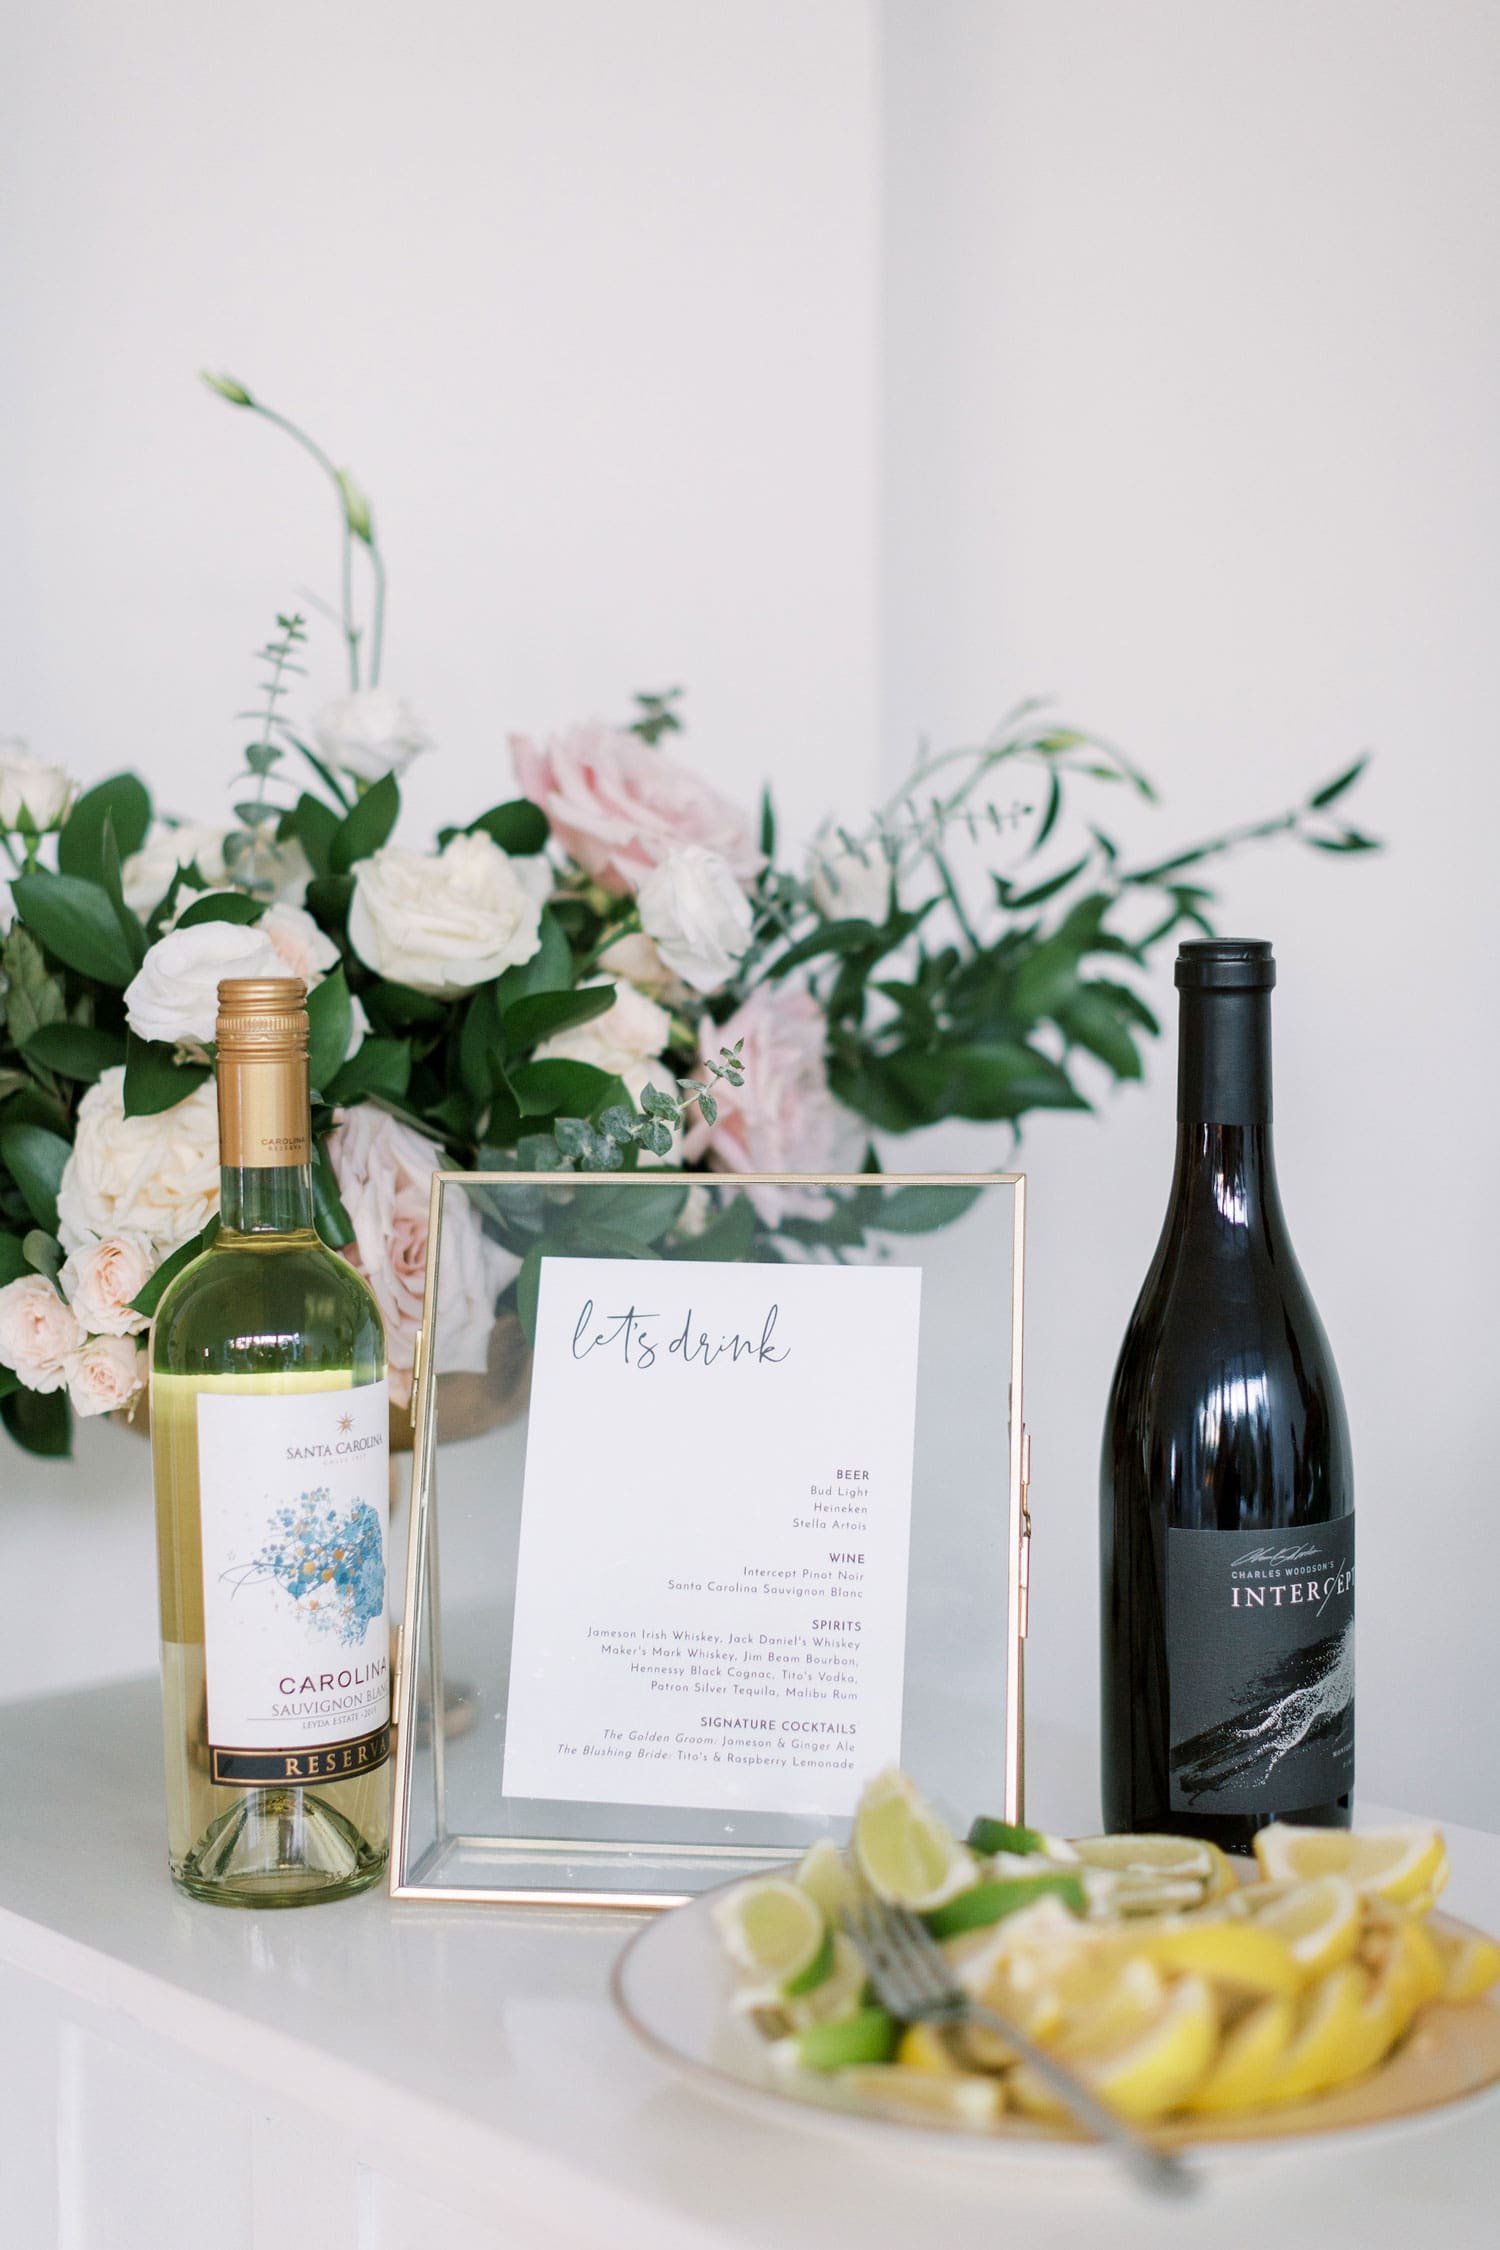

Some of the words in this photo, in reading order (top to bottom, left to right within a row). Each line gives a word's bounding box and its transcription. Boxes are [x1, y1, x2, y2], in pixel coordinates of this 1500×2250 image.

[572, 1299, 661, 1369] let's
[668, 1303, 792, 1366] drink
[286, 1444, 333, 1460] SANTA
[335, 1432, 383, 1455] CAROLINA
[836, 1468, 870, 1481] BEER
[810, 1484, 833, 1496] Bud
[837, 1486, 869, 1499] Light
[813, 1501, 868, 1514] Heineken
[792, 1517, 827, 1529] Stella
[831, 1519, 867, 1531] Artois
[828, 1552, 865, 1565] WINE
[743, 1566, 797, 1580] Intercept
[802, 1568, 833, 1580] Pinot
[837, 1570, 864, 1581] Noir
[1231, 1569, 1281, 1580] CHARLES
[1284, 1560, 1335, 1577] WOODSON'S
[667, 1579, 702, 1591] Santa
[707, 1581, 758, 1593] Carolina
[763, 1583, 825, 1598] Sauvignon
[830, 1586, 863, 1599] Blanc
[811, 1619, 862, 1632] SPIRITS
[587, 1626, 637, 1639] Jameson
[641, 1628, 667, 1640] Irish
[728, 1632, 753, 1645] Jack
[759, 1633, 807, 1647] Daniel's
[812, 1636, 861, 1651] Whiskey
[601, 1644, 647, 1656] Maker's
[652, 1645, 681, 1657] Mark
[743, 1650, 762, 1662] Jim
[767, 1651, 800, 1663] Beam
[278, 1655, 387, 1695] CAROLINA
[630, 1662, 685, 1677] Hennessy
[690, 1664, 721, 1677] Black
[782, 1669, 813, 1681] Tito's
[650, 1680, 689, 1692] Patron
[694, 1681, 727, 1694] Silver
[785, 1687, 827, 1699] Malibu
[832, 1688, 858, 1700] Rum
[271, 1693, 363, 1718] SAUVIGNON
[332, 1712, 359, 1726] ESTATE
[700, 1716, 777, 1731] SIGNATURE
[781, 1720, 857, 1735] COCKTAILS
[603, 1728, 624, 1740] The
[628, 1730, 670, 1743] Golden
[721, 1735, 772, 1748] Jameson
[776, 1737, 786, 1749] &
[791, 1738, 830, 1753] Ginger
[836, 1741, 855, 1752] Ale
[285, 1736, 387, 1777] RESERVA
[558, 1743, 577, 1755] The
[582, 1744, 632, 1760] Blushing
[677, 1749, 708, 1762] Tito's
[712, 1751, 721, 1762] &
[727, 1752, 787, 1769] Raspberry
[792, 1756, 854, 1769] Lemonade
